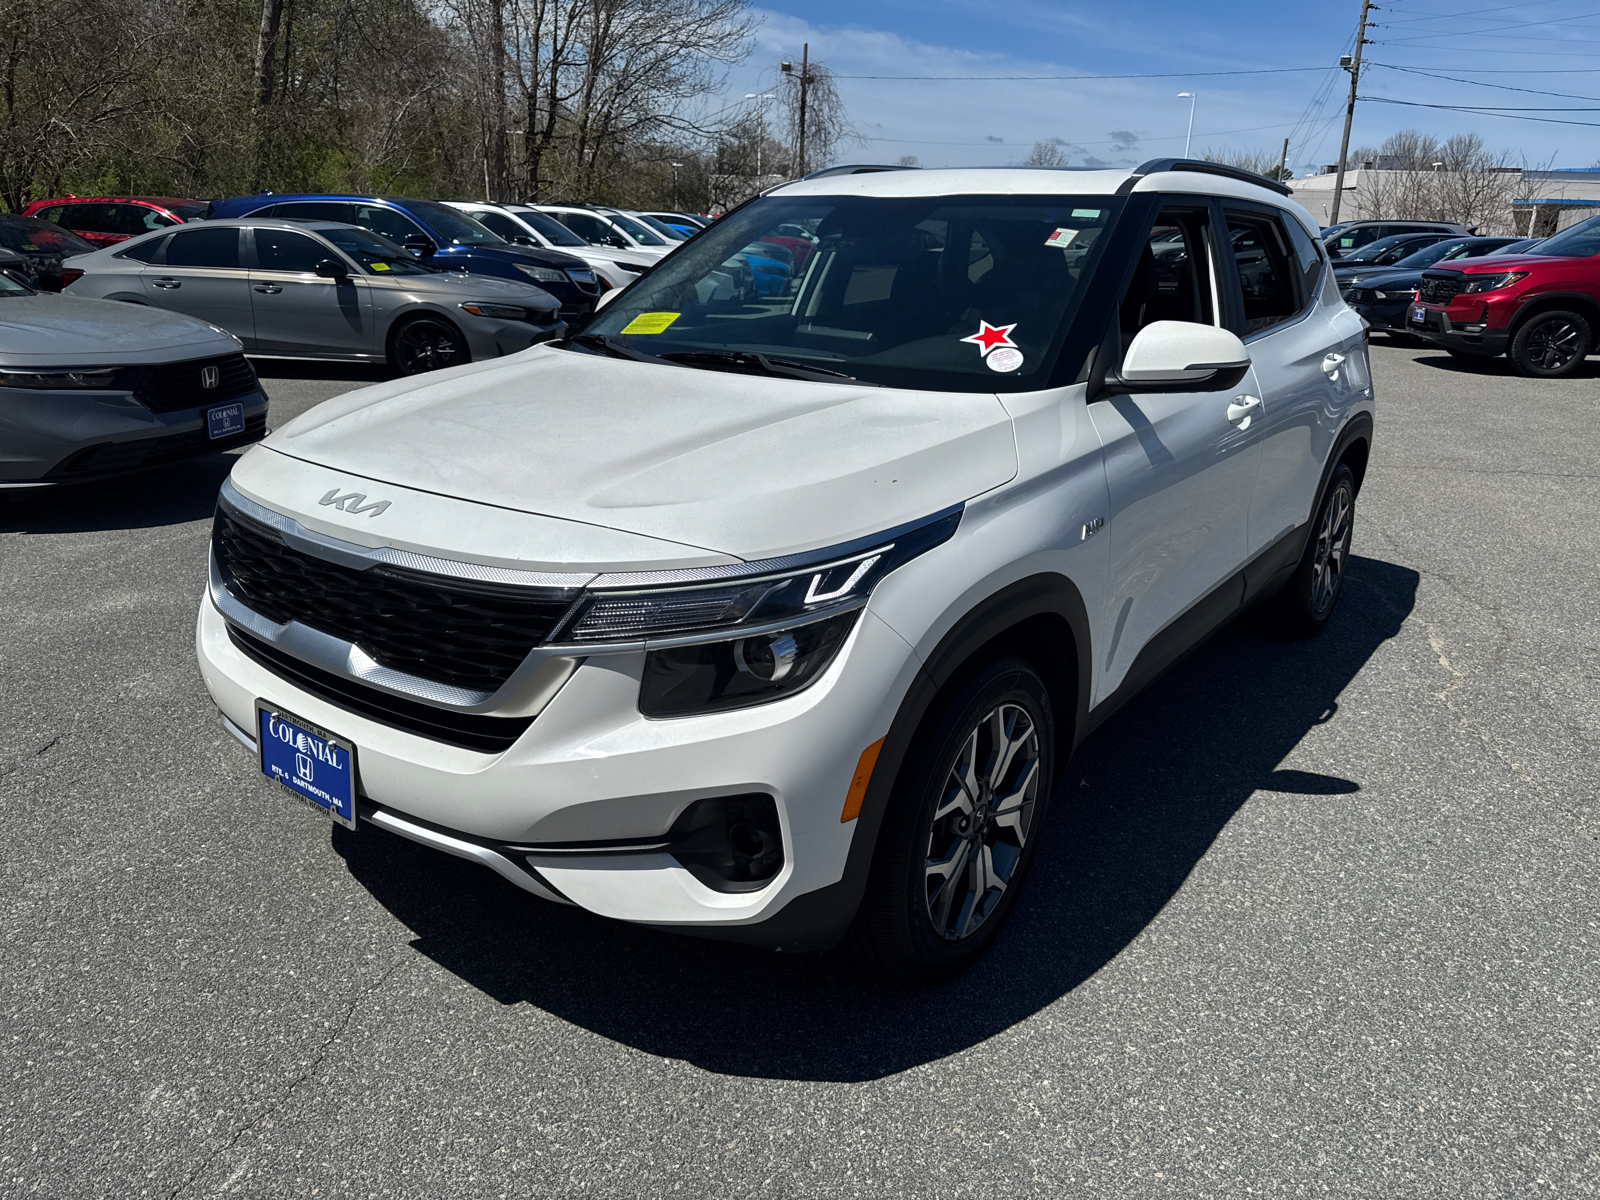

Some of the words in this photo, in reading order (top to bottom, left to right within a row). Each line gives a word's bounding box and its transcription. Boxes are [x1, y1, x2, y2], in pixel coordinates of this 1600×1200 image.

[269, 718, 342, 769] COLONIAL
[271, 764, 284, 777] RTE.
[292, 776, 332, 803] DARTMOUTH,
[332, 797, 343, 808] MA
